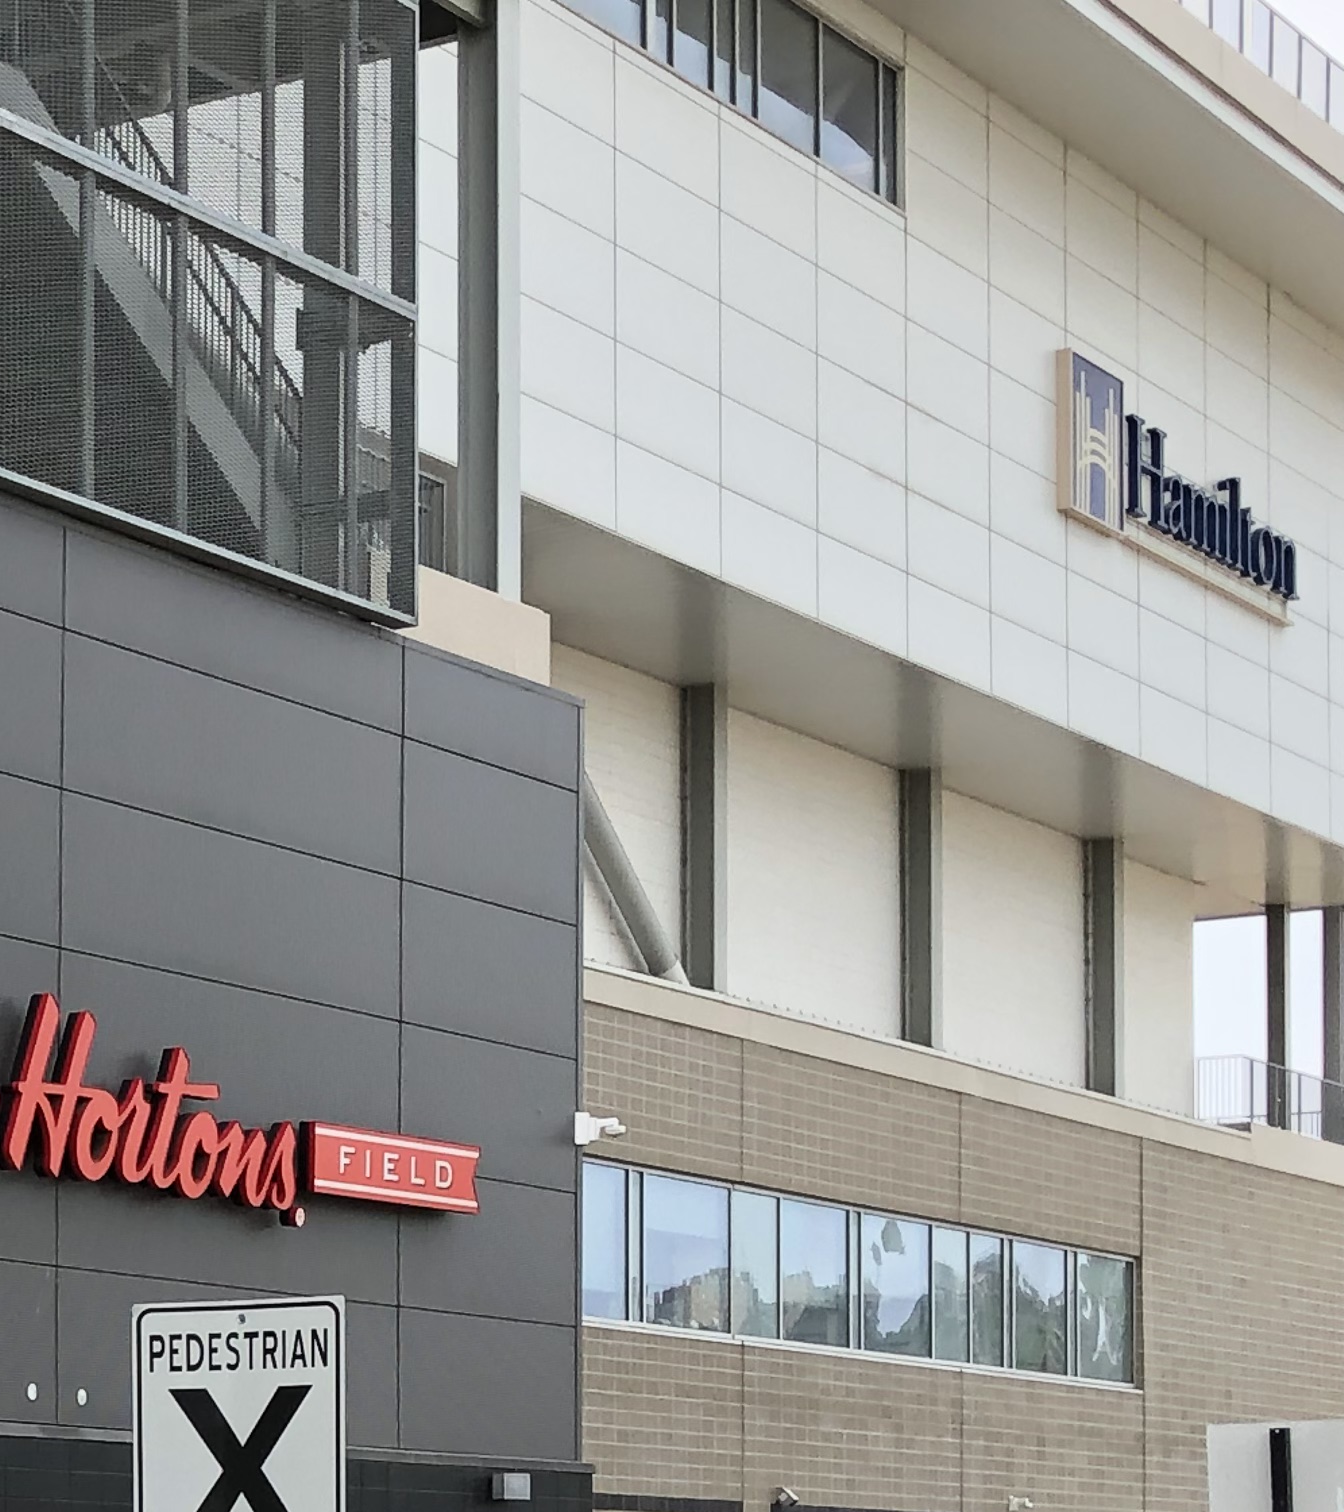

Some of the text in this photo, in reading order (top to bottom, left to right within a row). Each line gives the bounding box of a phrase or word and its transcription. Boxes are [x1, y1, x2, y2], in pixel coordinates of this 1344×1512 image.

[1124, 413, 1300, 601] Hamilton
[338, 1144, 455, 1192] FIELD
[148, 1327, 330, 1374] PEDESTRIAN
